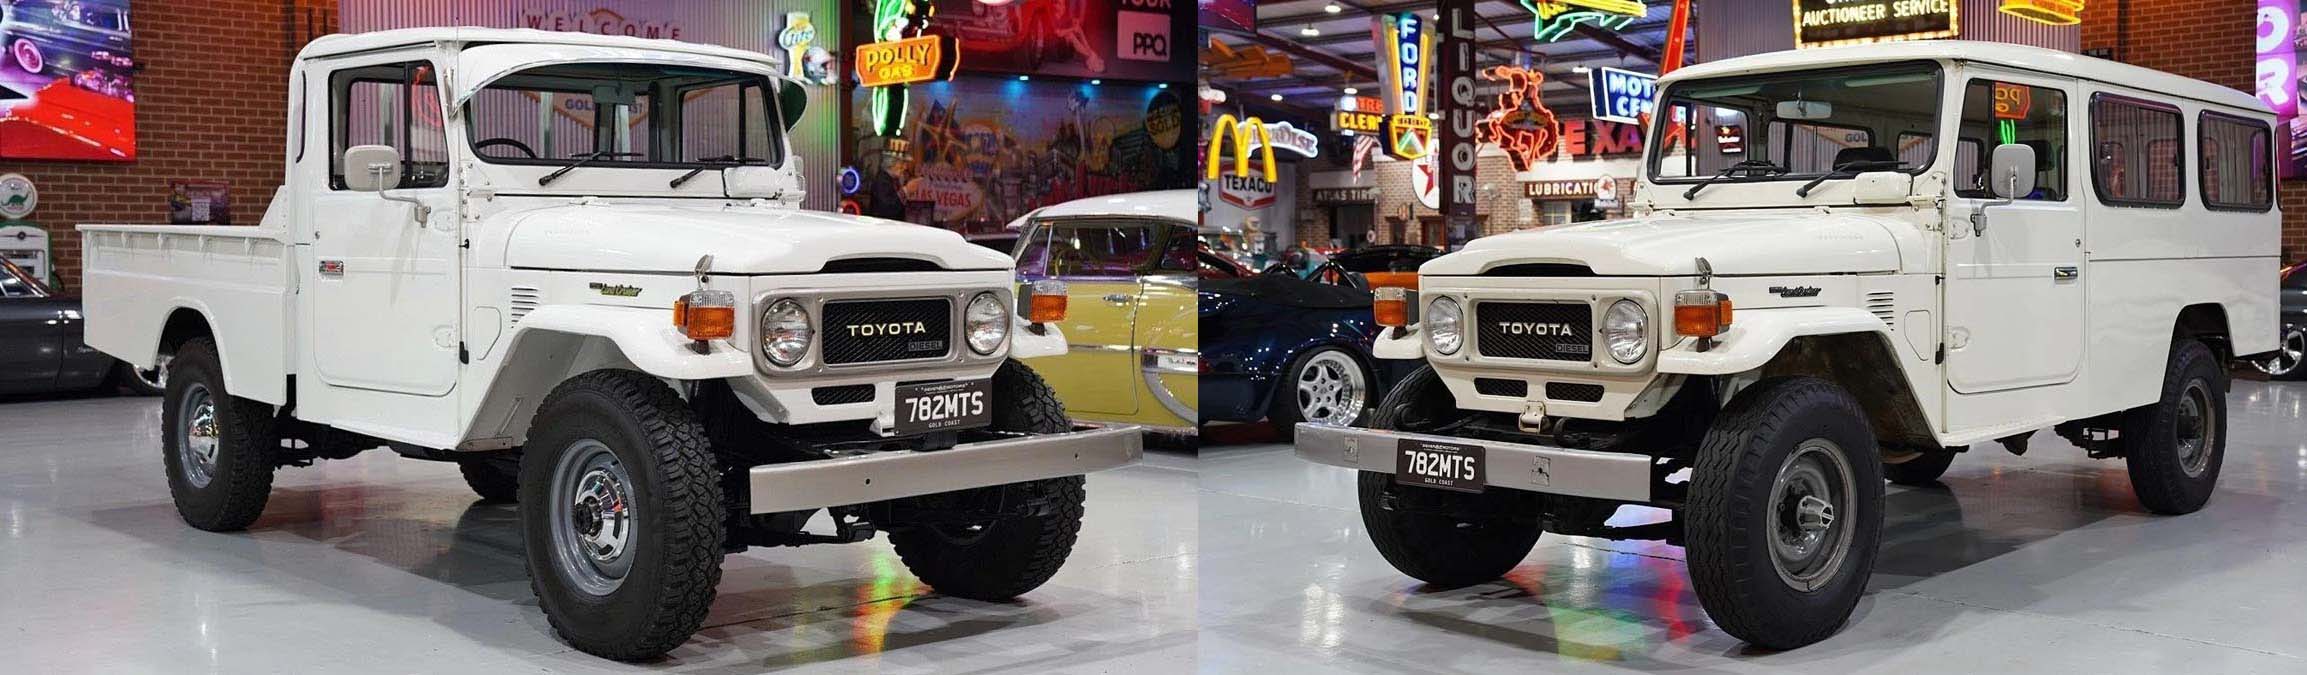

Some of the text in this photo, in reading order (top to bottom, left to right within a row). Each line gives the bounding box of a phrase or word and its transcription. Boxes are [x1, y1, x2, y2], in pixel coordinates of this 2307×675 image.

[1802, 0, 1949, 27] AUCTIONEER SERVICE
[527, 15, 681, 40] WELCOME
[1133, 32, 1167, 57] PPQ
[867, 43, 930, 72] POLLY
[1400, 17, 1419, 113] FORD
[878, 65, 914, 80] GAS
[1608, 73, 1656, 98] MOT
[1452, 8, 1476, 205] LIQUOR
[1564, 117, 1643, 155] EXA
[937, 190, 972, 208] VEGAS
[847, 321, 927, 337] TOYOTA
[1499, 322, 1573, 336] TOYOTA
[908, 340, 943, 352] DIESEL
[1555, 344, 1589, 354] DIESEL
[905, 391, 985, 423] 782MTS
[928, 419, 961, 429] GOLD COAST
[1404, 450, 1476, 481] 782MTS
[1438, 479, 1454, 487] COAST
